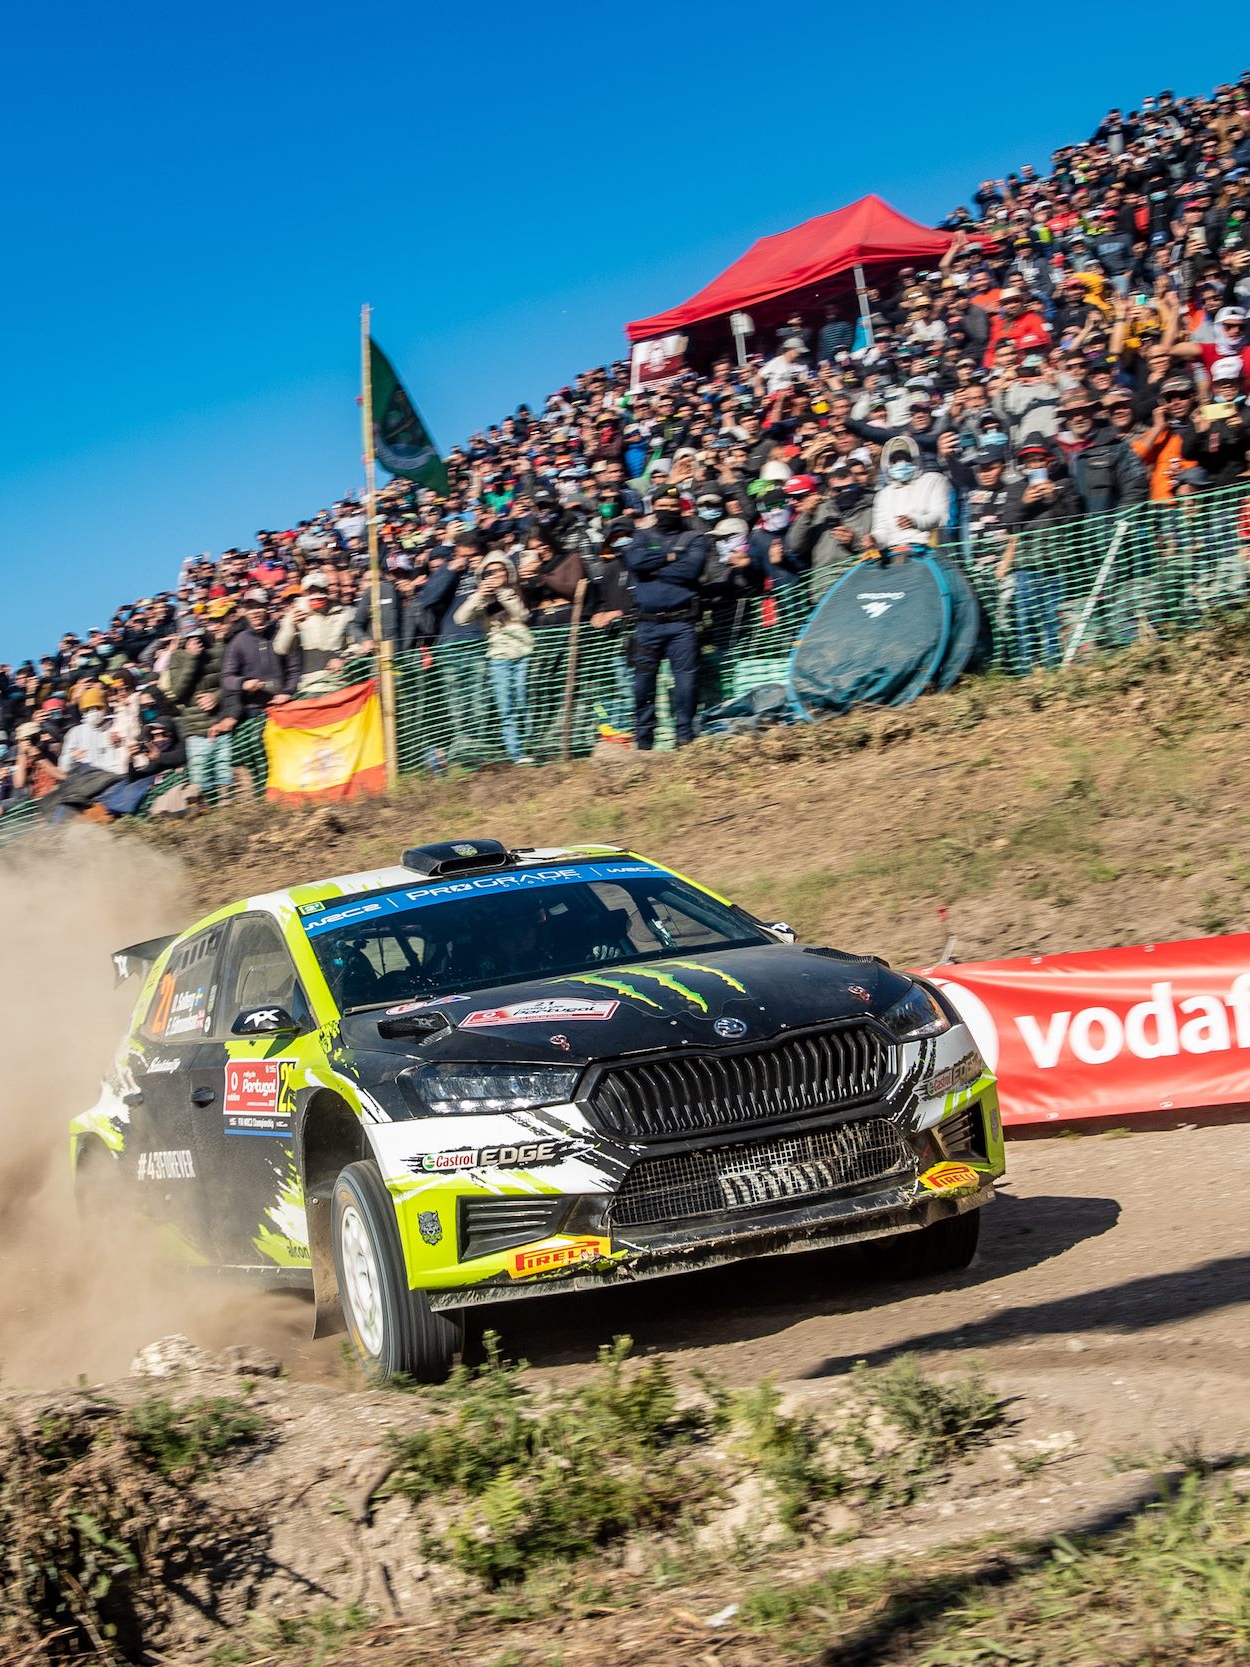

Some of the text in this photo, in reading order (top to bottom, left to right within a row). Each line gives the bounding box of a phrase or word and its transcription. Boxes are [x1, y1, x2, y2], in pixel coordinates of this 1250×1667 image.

[405, 868, 580, 901] PROGRADE
[304, 903, 382, 931] WRC2
[153, 971, 177, 1035] 21
[513, 1005, 596, 1017] Portugal
[242, 1079, 277, 1097] Portugal
[436, 1142, 557, 1168] Castrol EDGE
[927, 1166, 977, 1189] PIRELLI
